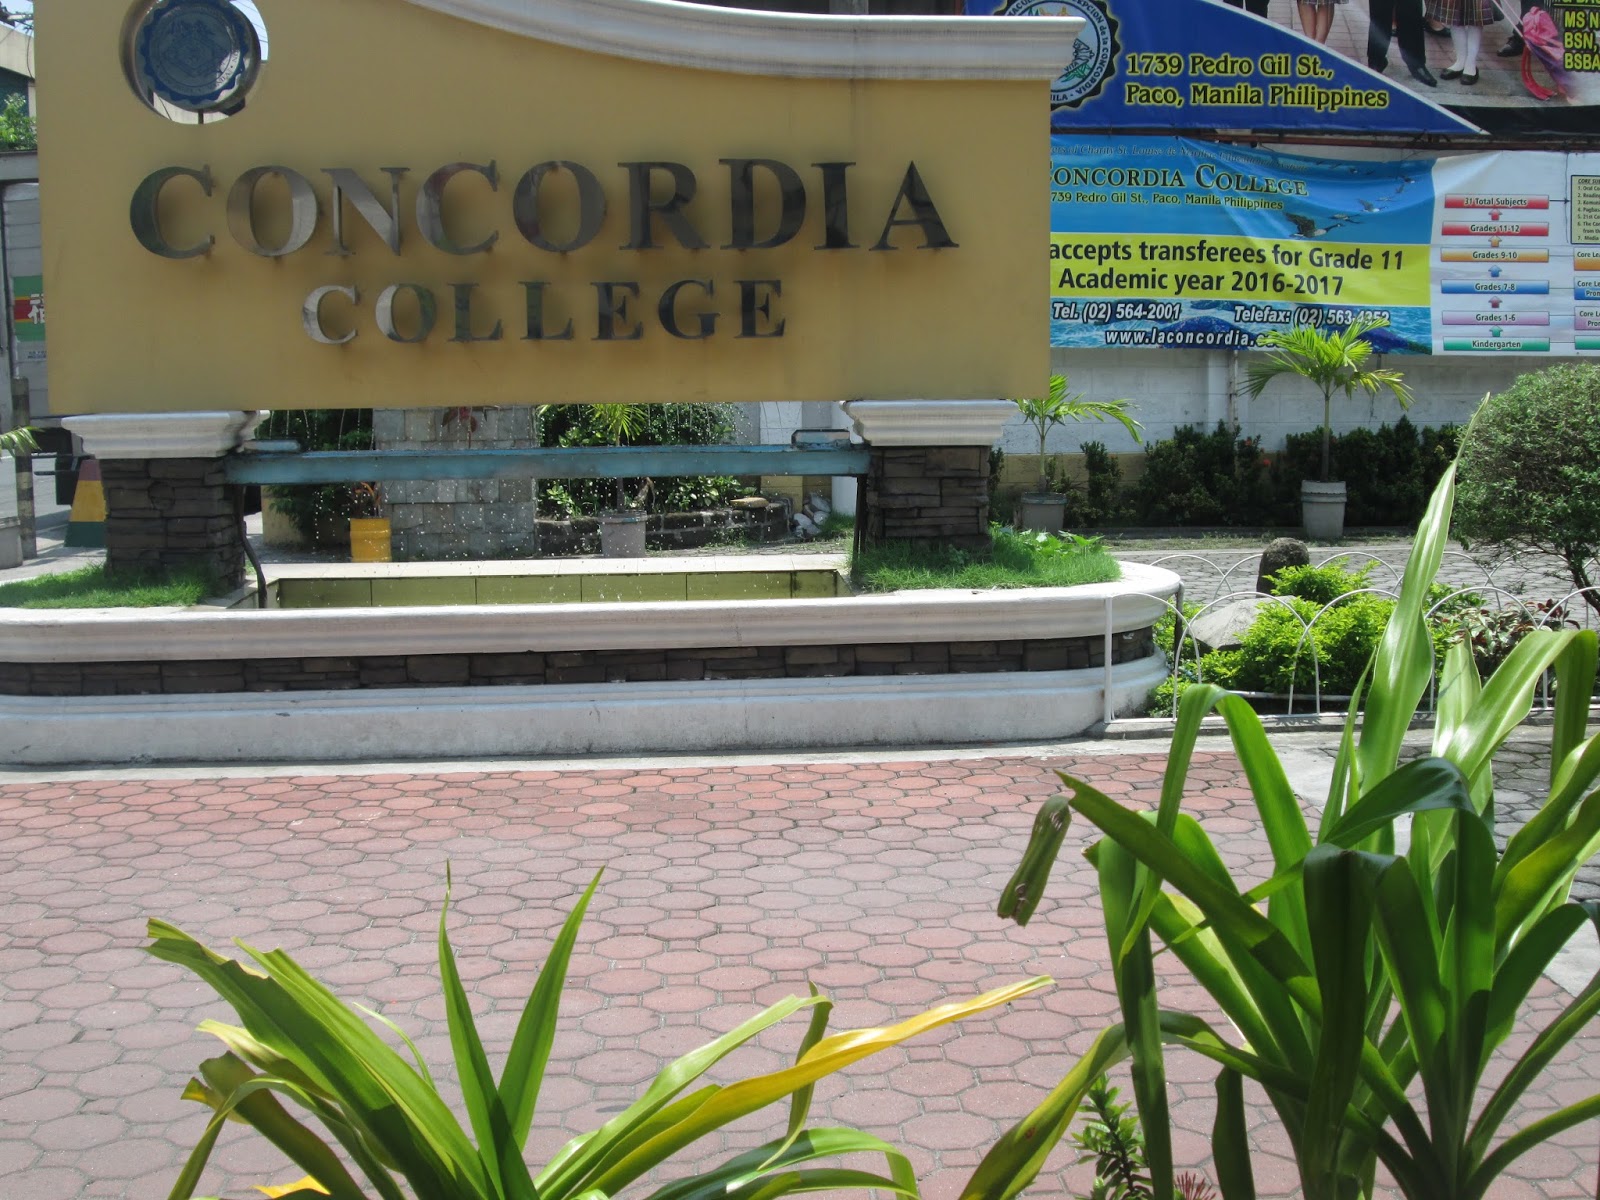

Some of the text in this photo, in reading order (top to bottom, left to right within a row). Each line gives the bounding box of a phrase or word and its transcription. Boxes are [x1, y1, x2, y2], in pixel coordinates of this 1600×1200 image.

[1564, 11, 1586, 28] MS
[1564, 32, 1598, 52] BSN,
[1075, 48, 1109, 94] CONCORDIA
[1126, 54, 1333, 79] 1739 Pedro Gil St.,
[1126, 84, 1388, 111] Paco, Manila Philippines
[1050, 161, 1185, 188] ONCORDIA
[1195, 164, 1308, 196] COLLEGE
[130, 158, 960, 259] CONCORDIA
[1051, 192, 1072, 202] 739
[1075, 192, 1107, 203] Pedro
[1111, 192, 1126, 203] Gil
[1153, 193, 1180, 205] Paco,
[1185, 193, 1221, 205] Manila
[1224, 196, 1283, 210] Philippines
[1465, 197, 1527, 207] 31 Total Subjects
[1470, 224, 1520, 232] Grades 11-12
[1050, 240, 1404, 271] accepts transferees for Grade 11
[1472, 251, 1517, 259] Grades 9-10
[1058, 268, 1344, 296] Academic year 2016-2017
[1475, 283, 1515, 291] Grades 7-8
[301, 278, 787, 345] COLLEGE
[1053, 303, 1182, 323] Tel. (02) 564-2001
[1234, 306, 1291, 324] Telefax:
[1294, 307, 1323, 326] (02)
[1476, 314, 1516, 322] Grades 1-6
[1472, 340, 1521, 349] Kindergarten
